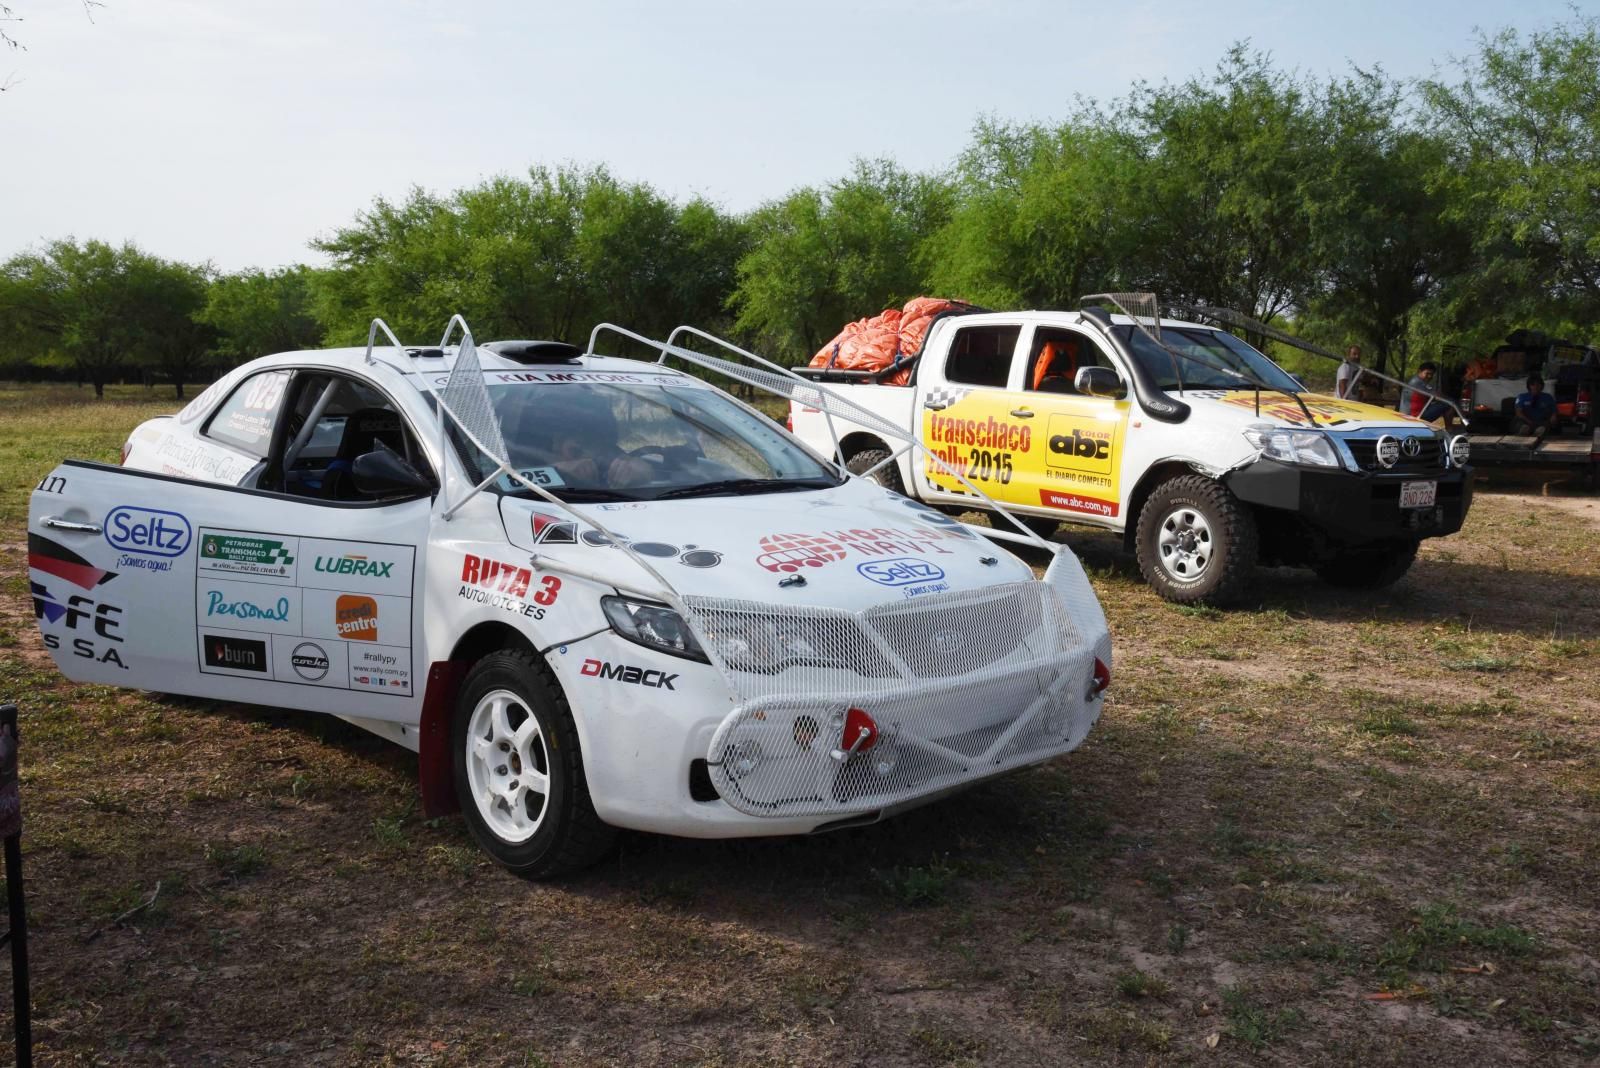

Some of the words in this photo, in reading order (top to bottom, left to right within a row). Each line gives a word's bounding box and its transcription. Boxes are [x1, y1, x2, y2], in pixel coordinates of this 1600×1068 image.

[495, 374, 544, 383] KIA
[546, 373, 643, 384] MOTORS
[244, 374, 289, 410] 825
[931, 413, 1031, 453] transchaco
[1080, 430, 1111, 439] COLOR
[1049, 429, 1109, 459] abc
[928, 445, 968, 485] rally
[968, 448, 1013, 485] 2015
[1046, 470, 1054, 479] EL
[1055, 471, 1076, 482] DIARIO
[1077, 474, 1112, 487] COMPLETO
[1050, 494, 1112, 515] www.abc.com.py
[1403, 491, 1417, 506] BND
[1419, 490, 1433, 505] 226
[112, 512, 184, 550] Seltz
[822, 528, 942, 542] WORLD
[225, 540, 264, 548] PETROBRAS
[846, 541, 955, 556] NAVI
[147, 560, 173, 572] agua!
[314, 556, 395, 578] LUBRAX
[864, 562, 939, 582] Seltz
[462, 554, 532, 598] RUTA
[534, 575, 562, 606] 3
[207, 591, 289, 622] Personal
[458, 585, 547, 621] AUTOMOTORES
[335, 616, 378, 634] centro
[73, 638, 130, 670] S.A.
[224, 643, 256, 665] burn
[363, 652, 397, 665] #rallypy
[353, 665, 409, 677] www.rally.com.py
